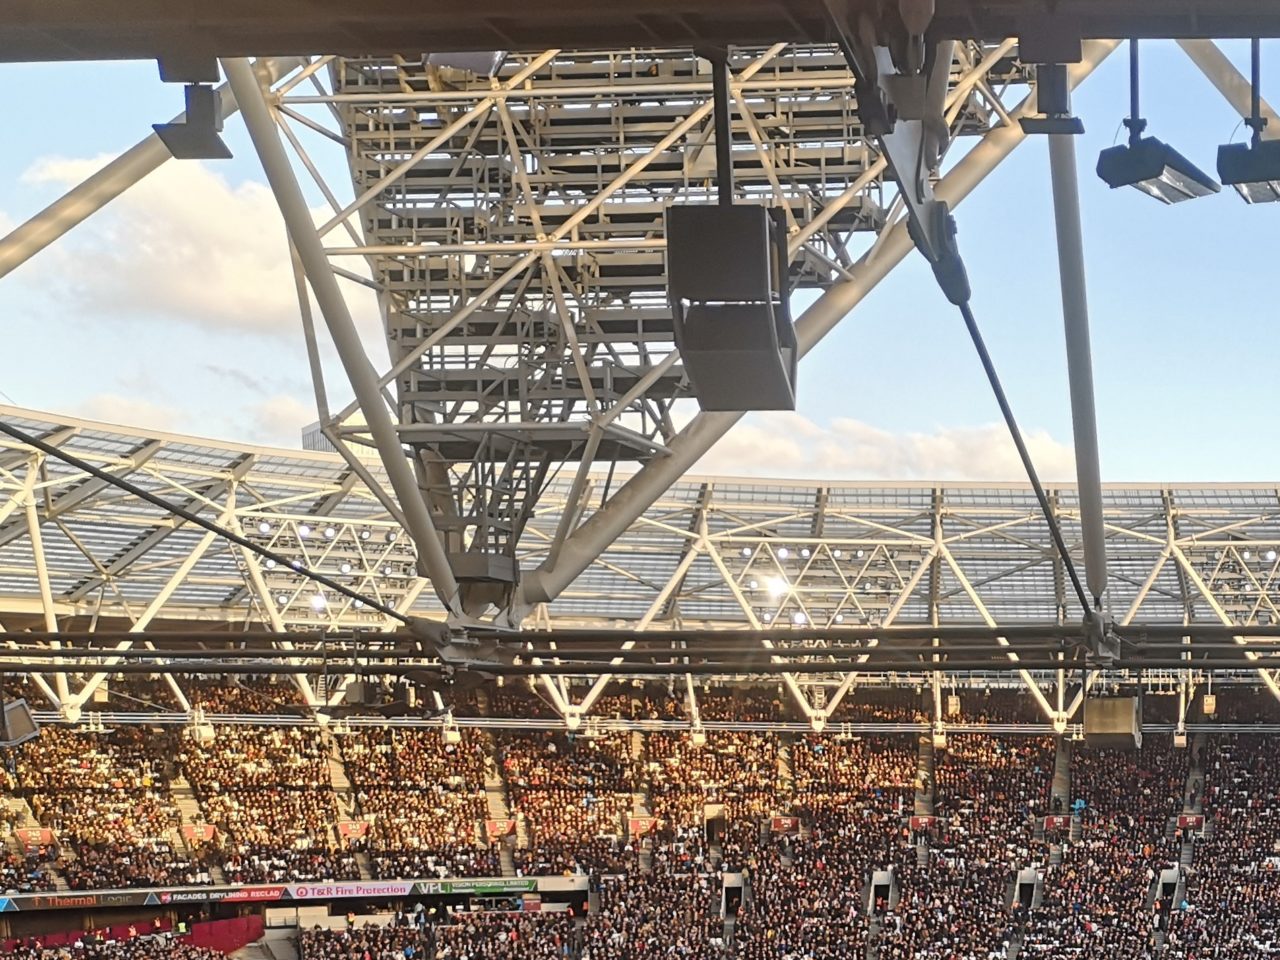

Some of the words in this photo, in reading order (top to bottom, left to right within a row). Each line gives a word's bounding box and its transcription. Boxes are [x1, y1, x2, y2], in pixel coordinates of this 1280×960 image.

[310, 886, 333, 897] T&R
[335, 886, 354, 896] Fire
[356, 885, 406, 896] Protection
[420, 883, 445, 894] VPL
[49, 895, 96, 906] Thermal
